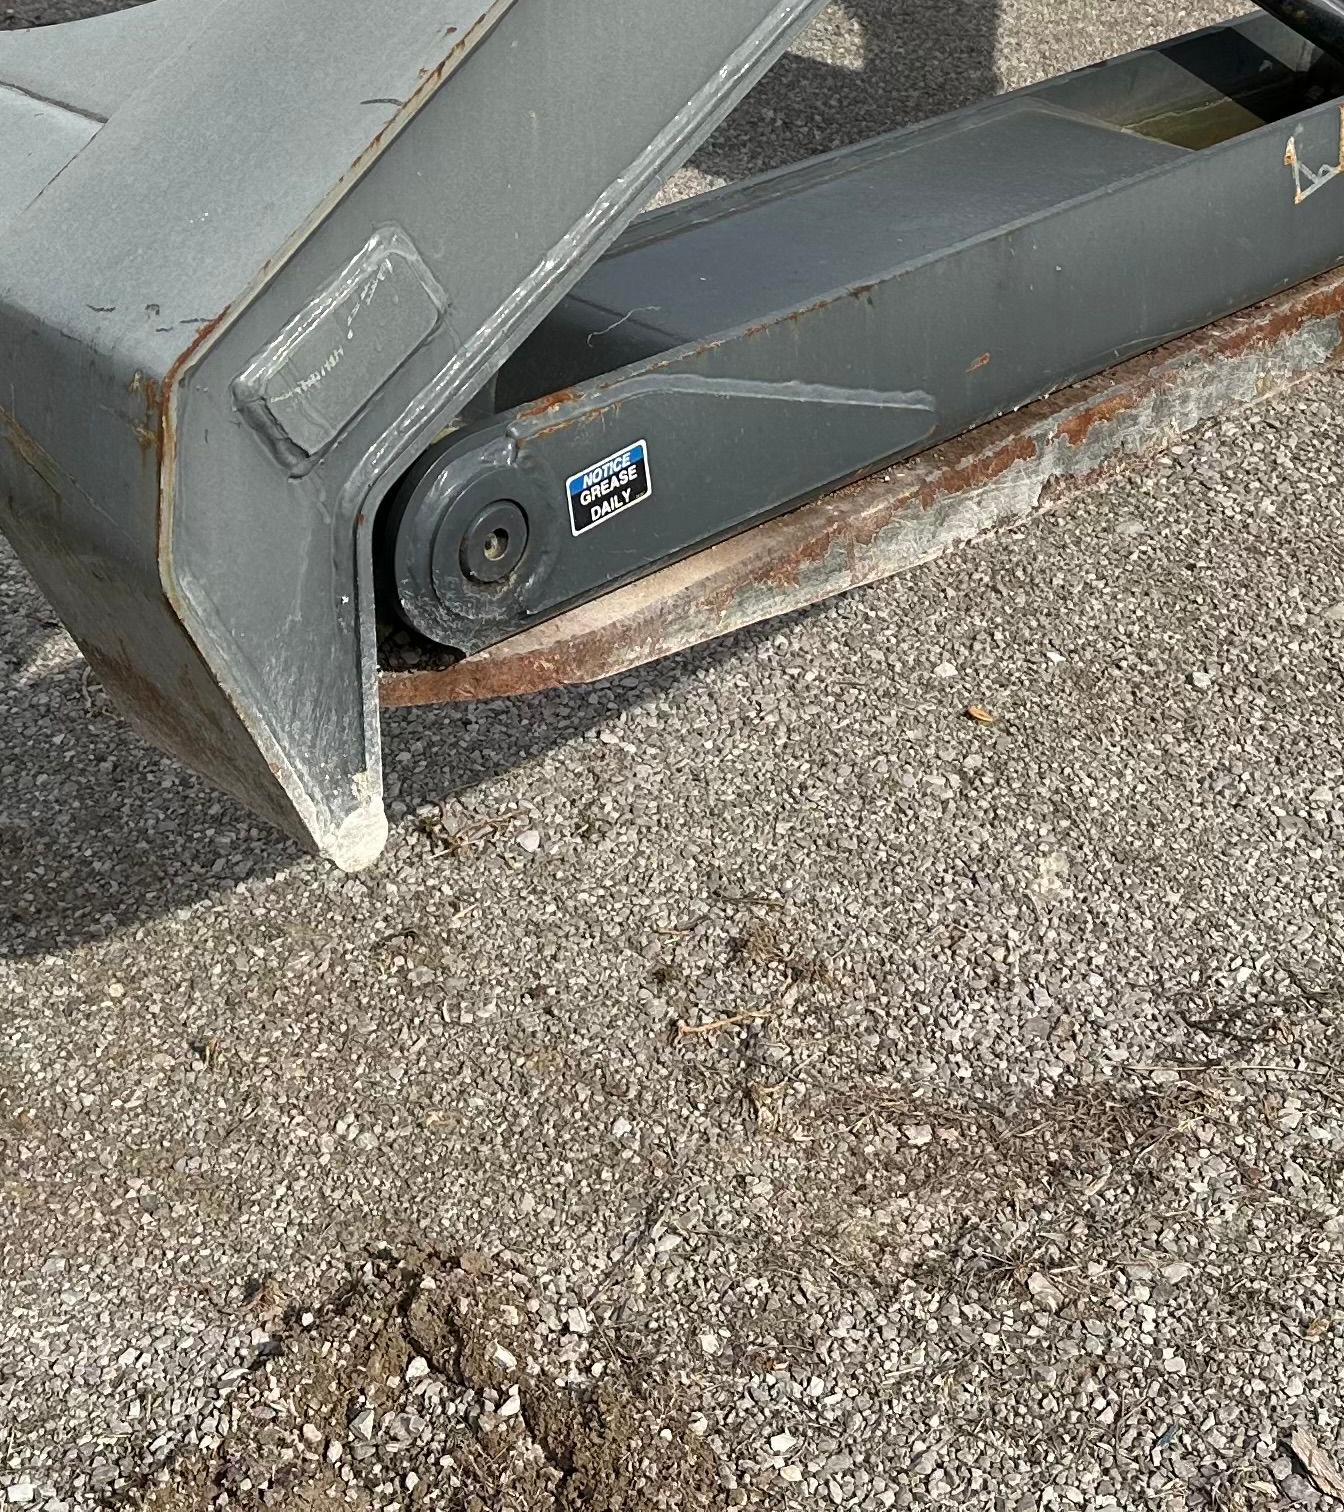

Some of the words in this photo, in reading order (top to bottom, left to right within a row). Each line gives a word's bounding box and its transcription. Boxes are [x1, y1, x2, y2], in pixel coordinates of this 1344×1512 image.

[579, 464, 638, 506] GREASE
[582, 451, 632, 489] NOTICE
[590, 487, 632, 522] DAILY
